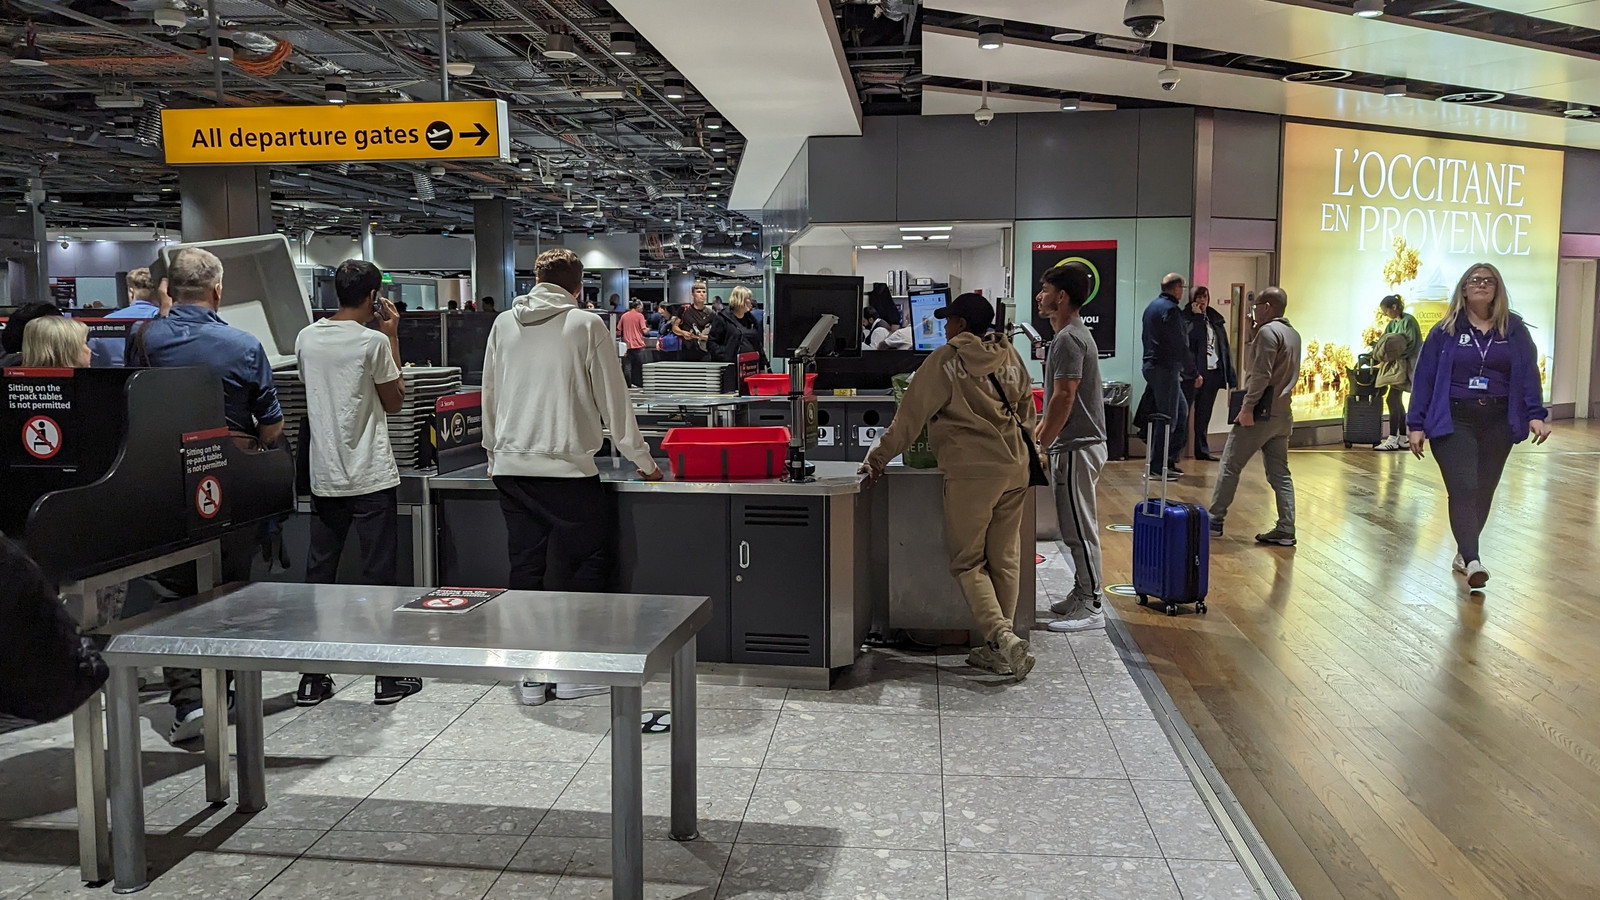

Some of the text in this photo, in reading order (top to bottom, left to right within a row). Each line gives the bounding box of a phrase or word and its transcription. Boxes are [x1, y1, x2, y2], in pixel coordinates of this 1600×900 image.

[192, 125, 419, 152] All departure gates
[1332, 148, 1525, 207] L'OCCITANE
[1320, 203, 1531, 256] EN PROVENCE
[1080, 315, 1100, 325] you
[8, 383, 34, 393] Sitting
[47, 383, 61, 392] the
[8, 392, 63, 402] re-pack tables
[9, 401, 16, 409] is
[32, 401, 71, 411] permitted
[186, 444, 221, 457] Sitting on the
[186, 452, 223, 466] re-pack tables
[186, 459, 228, 474] is not permitted
